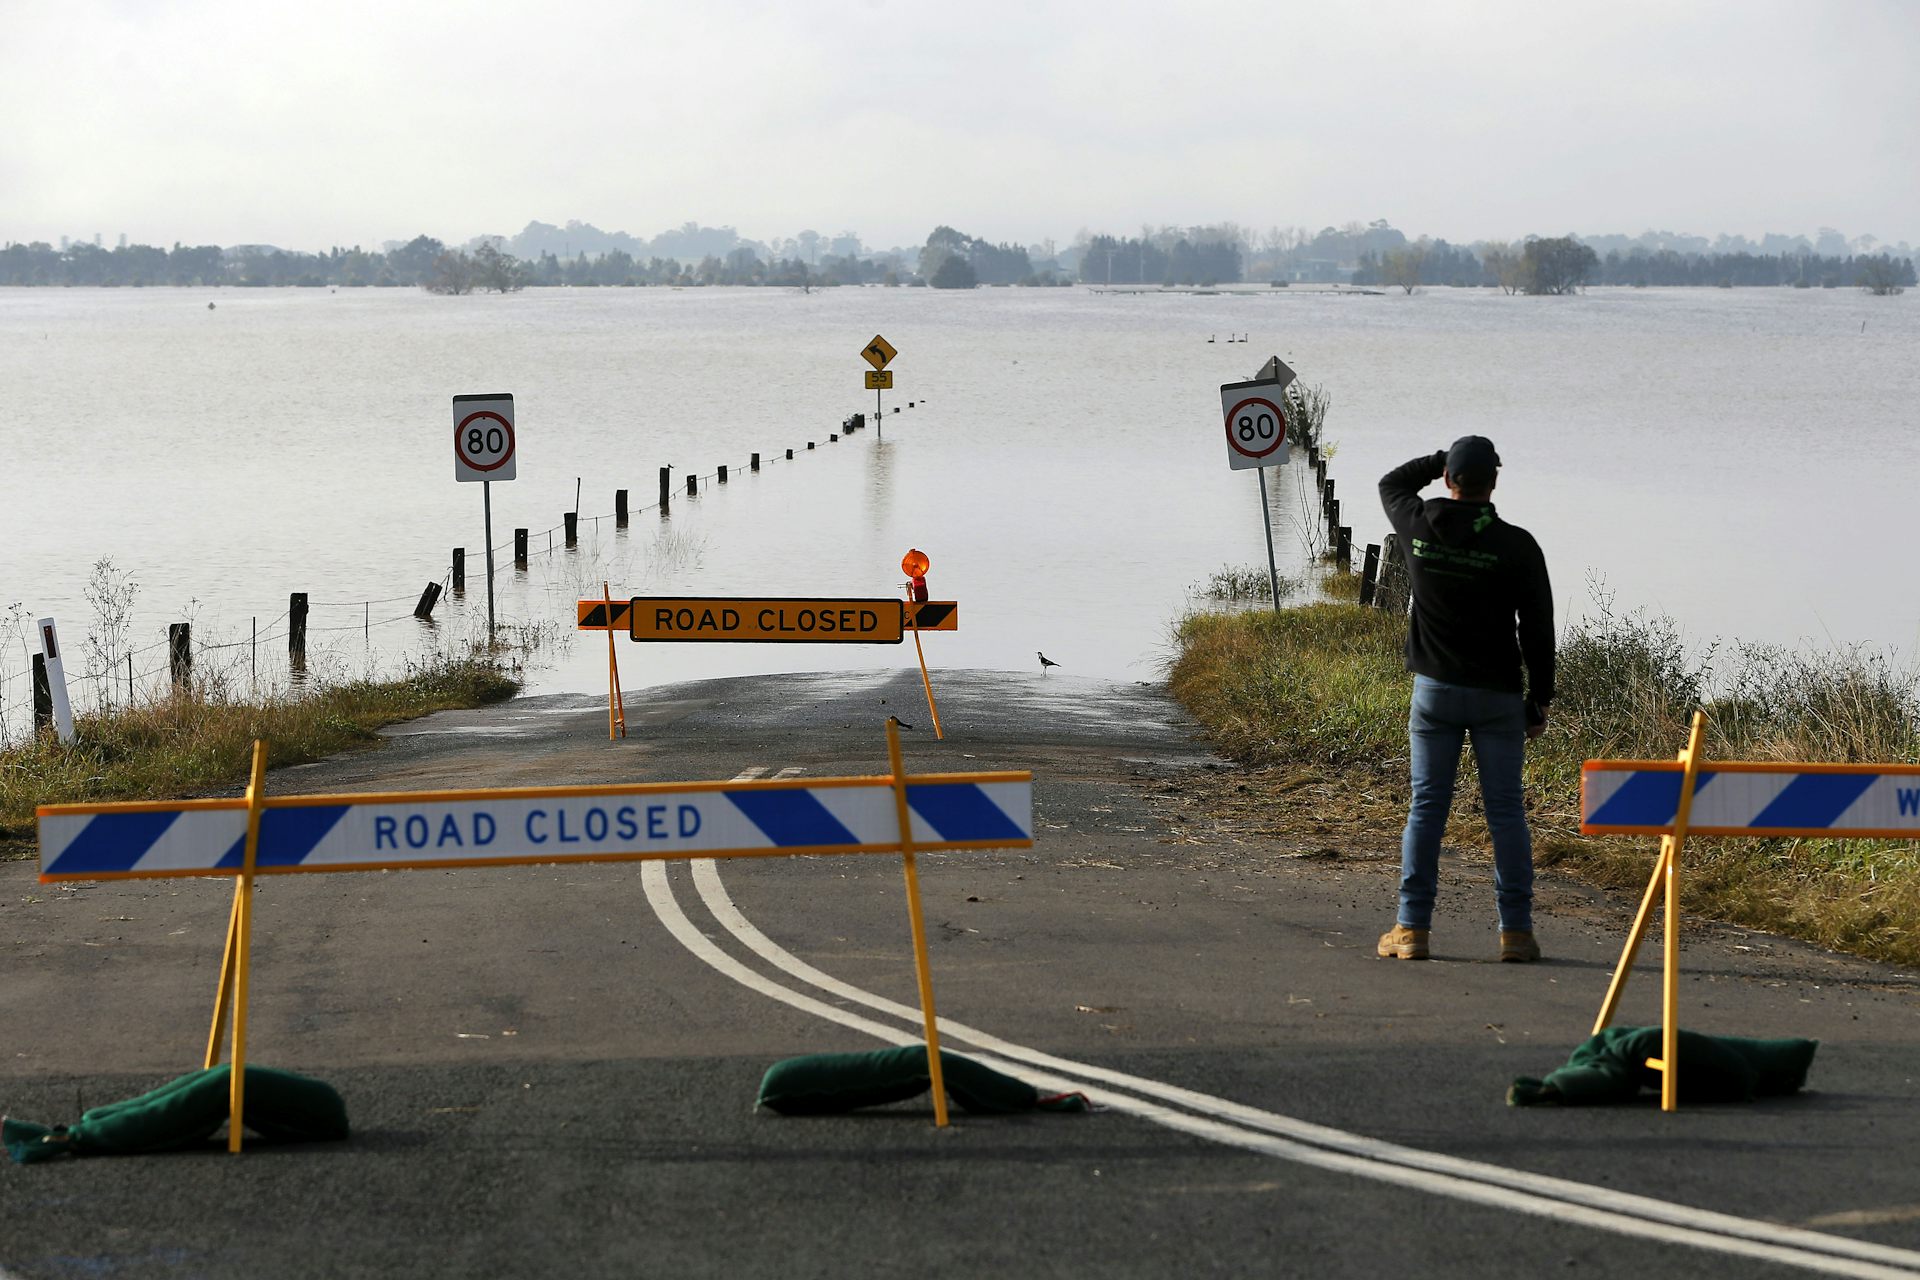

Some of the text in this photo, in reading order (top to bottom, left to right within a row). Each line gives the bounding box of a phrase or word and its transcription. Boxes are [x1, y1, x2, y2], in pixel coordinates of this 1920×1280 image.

[872, 373, 887, 382] 55
[467, 427, 504, 455] 80
[1239, 413, 1275, 442] 80
[655, 608, 878, 632] ROAD CLOSED
[374, 804, 702, 850] ROAD CLOSED
